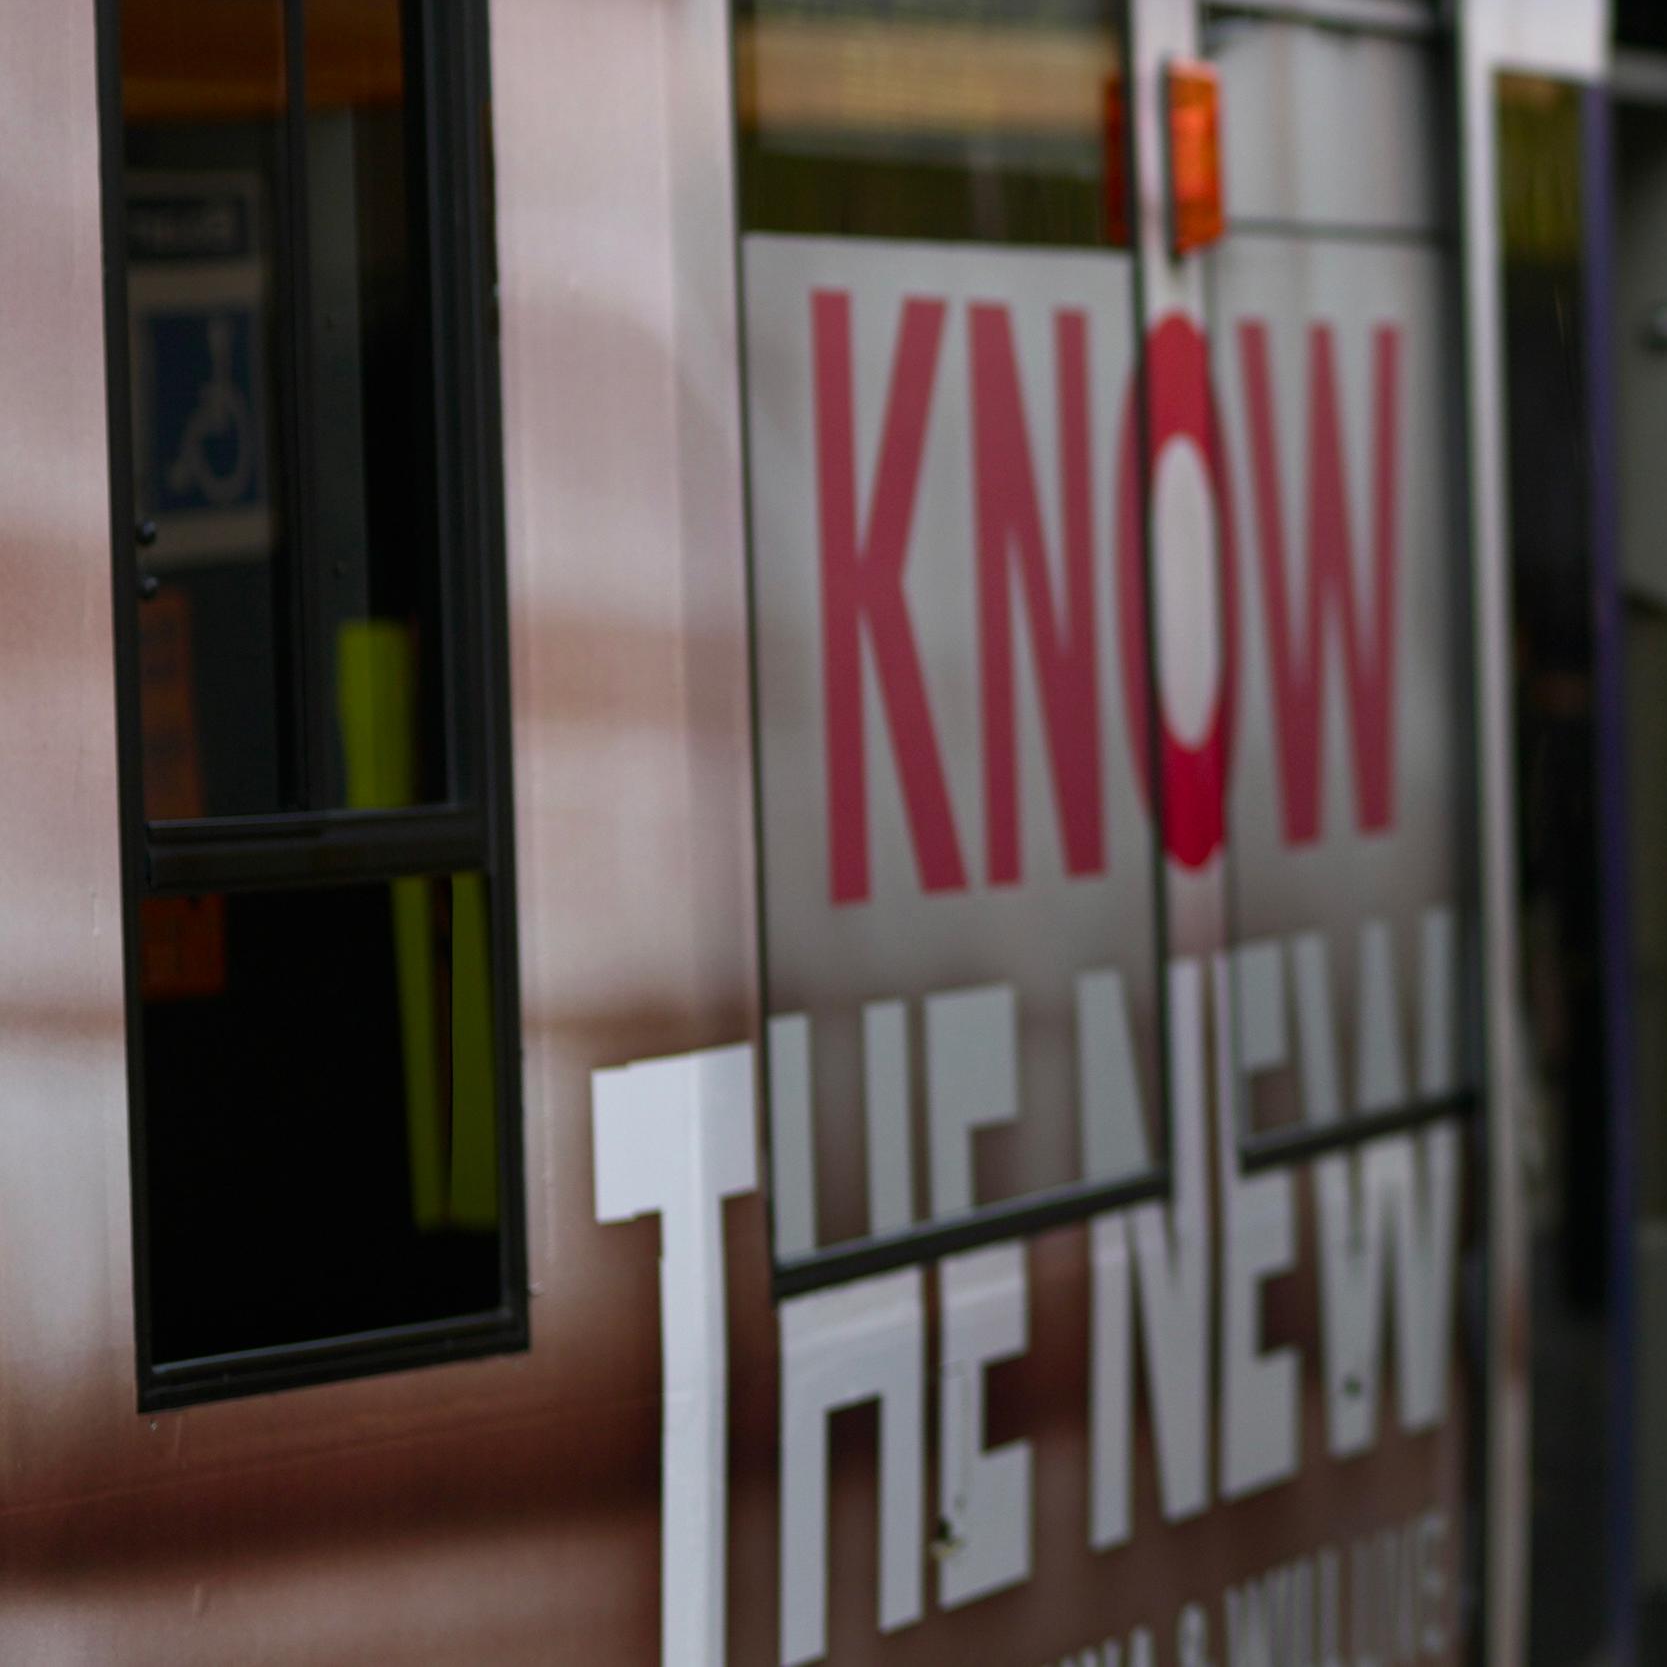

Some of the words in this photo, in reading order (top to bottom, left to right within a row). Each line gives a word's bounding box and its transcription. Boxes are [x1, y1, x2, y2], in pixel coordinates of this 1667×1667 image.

[809, 287, 1404, 909] KNOW
[592, 984, 1036, 1667] THE
[1076, 908, 1460, 1554] NEW
